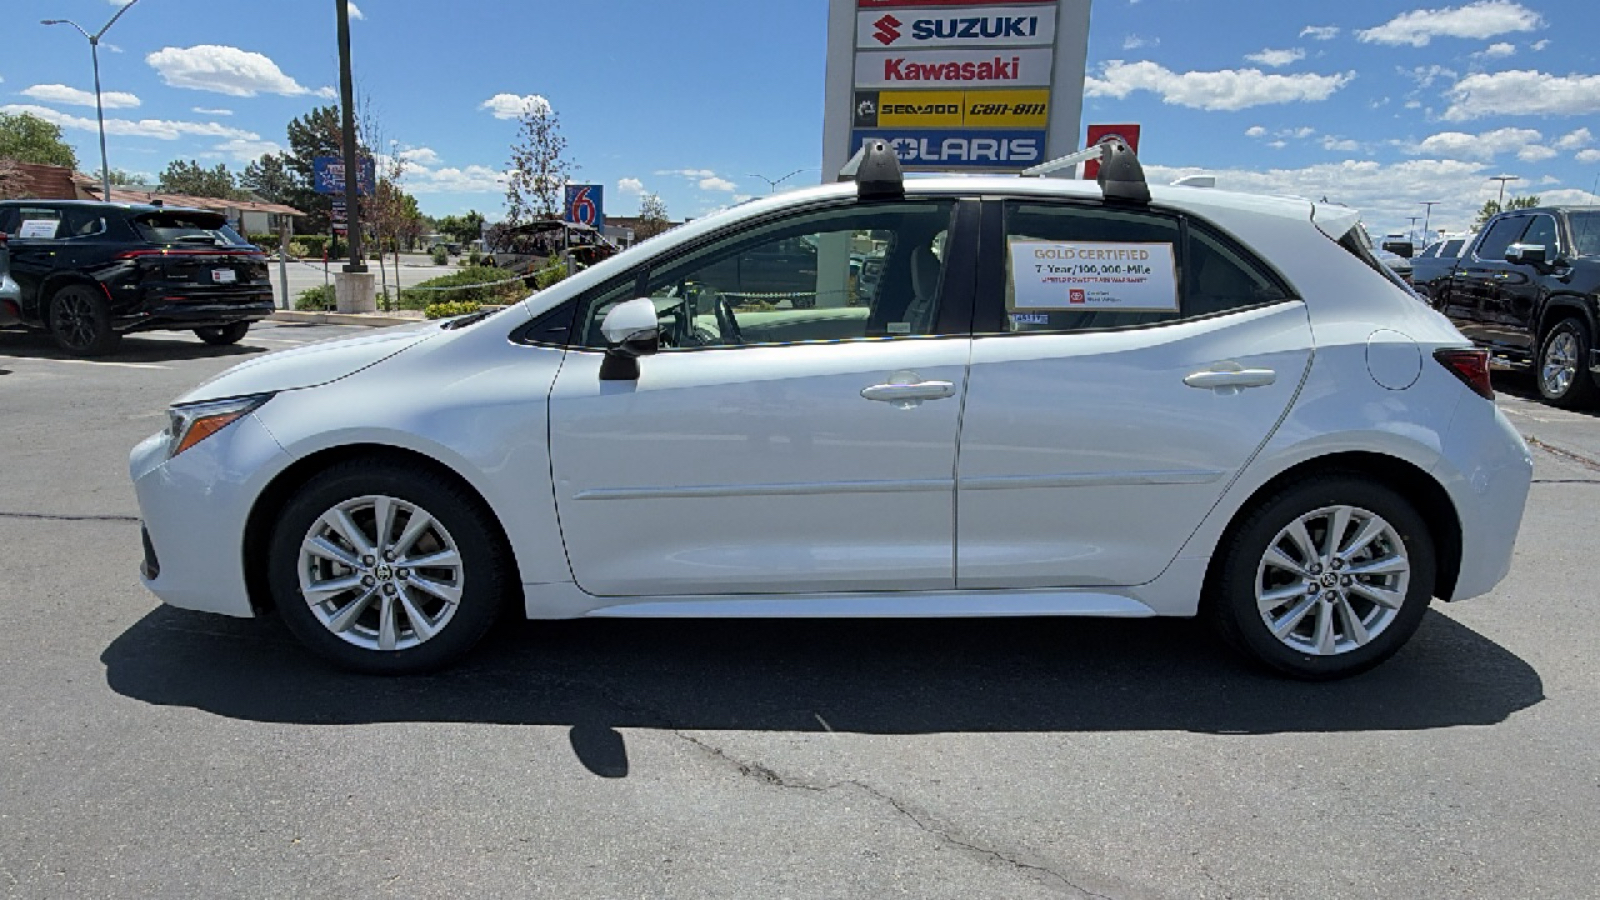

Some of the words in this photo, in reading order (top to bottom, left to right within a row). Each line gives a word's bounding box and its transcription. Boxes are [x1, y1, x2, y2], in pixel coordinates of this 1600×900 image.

[912, 16, 1038, 40] SUZUKI
[884, 57, 1020, 81] Kawasaki
[862, 138, 1038, 161] OLARIS
[572, 186, 596, 225] 6
[1034, 249, 1076, 260] GOLD
[1078, 249, 1150, 261] CERTIFIED
